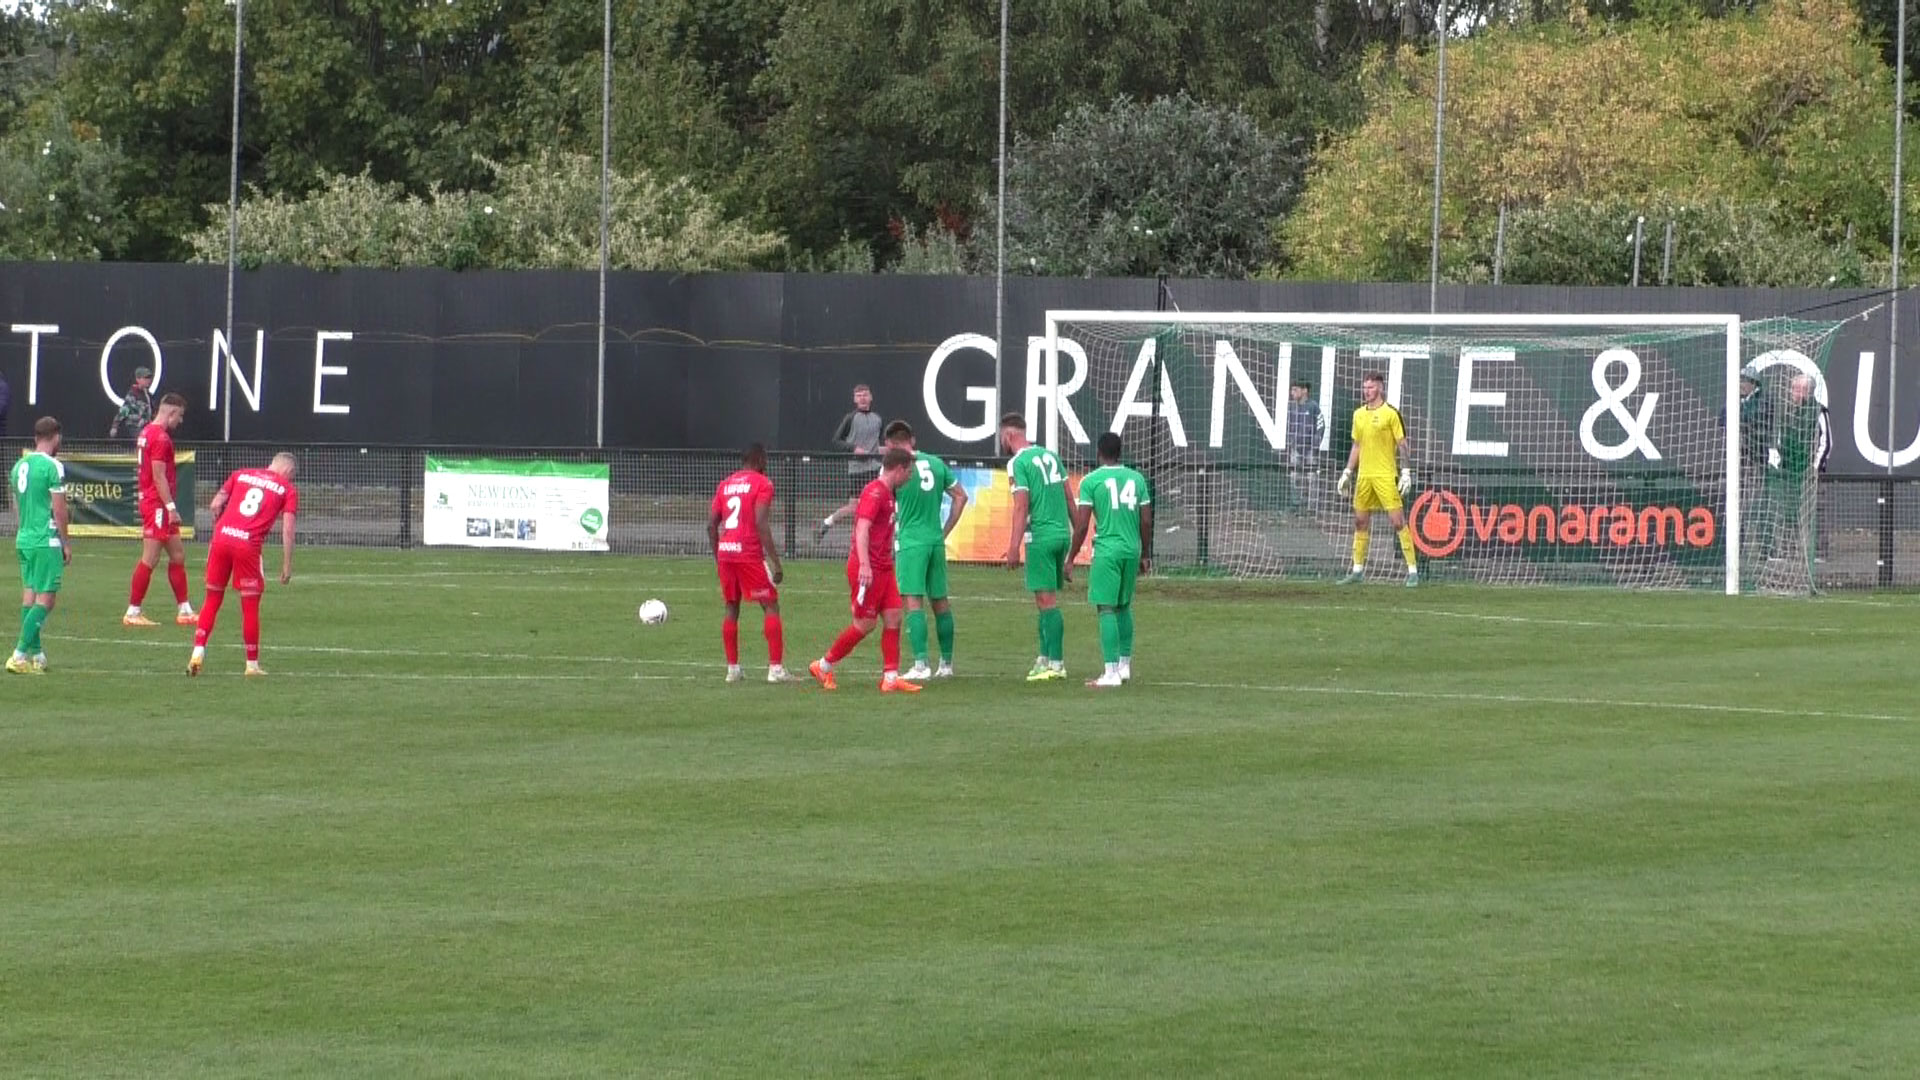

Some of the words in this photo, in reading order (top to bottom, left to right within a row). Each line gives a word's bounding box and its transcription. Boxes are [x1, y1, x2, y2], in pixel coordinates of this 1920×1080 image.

[11, 324, 353, 413] TONE
[922, 333, 1516, 457] GRANITE
[1579, 348, 1662, 460] &
[17, 461, 29, 493] 8
[915, 460, 934, 491] 5
[1032, 454, 1062, 485] 12
[65, 479, 122, 502] gsgate
[239, 487, 264, 516] 8
[467, 484, 537, 501] NEWTONS
[1105, 478, 1137, 510] 14
[725, 496, 741, 529] 2
[1471, 503, 1714, 546] vanarama
